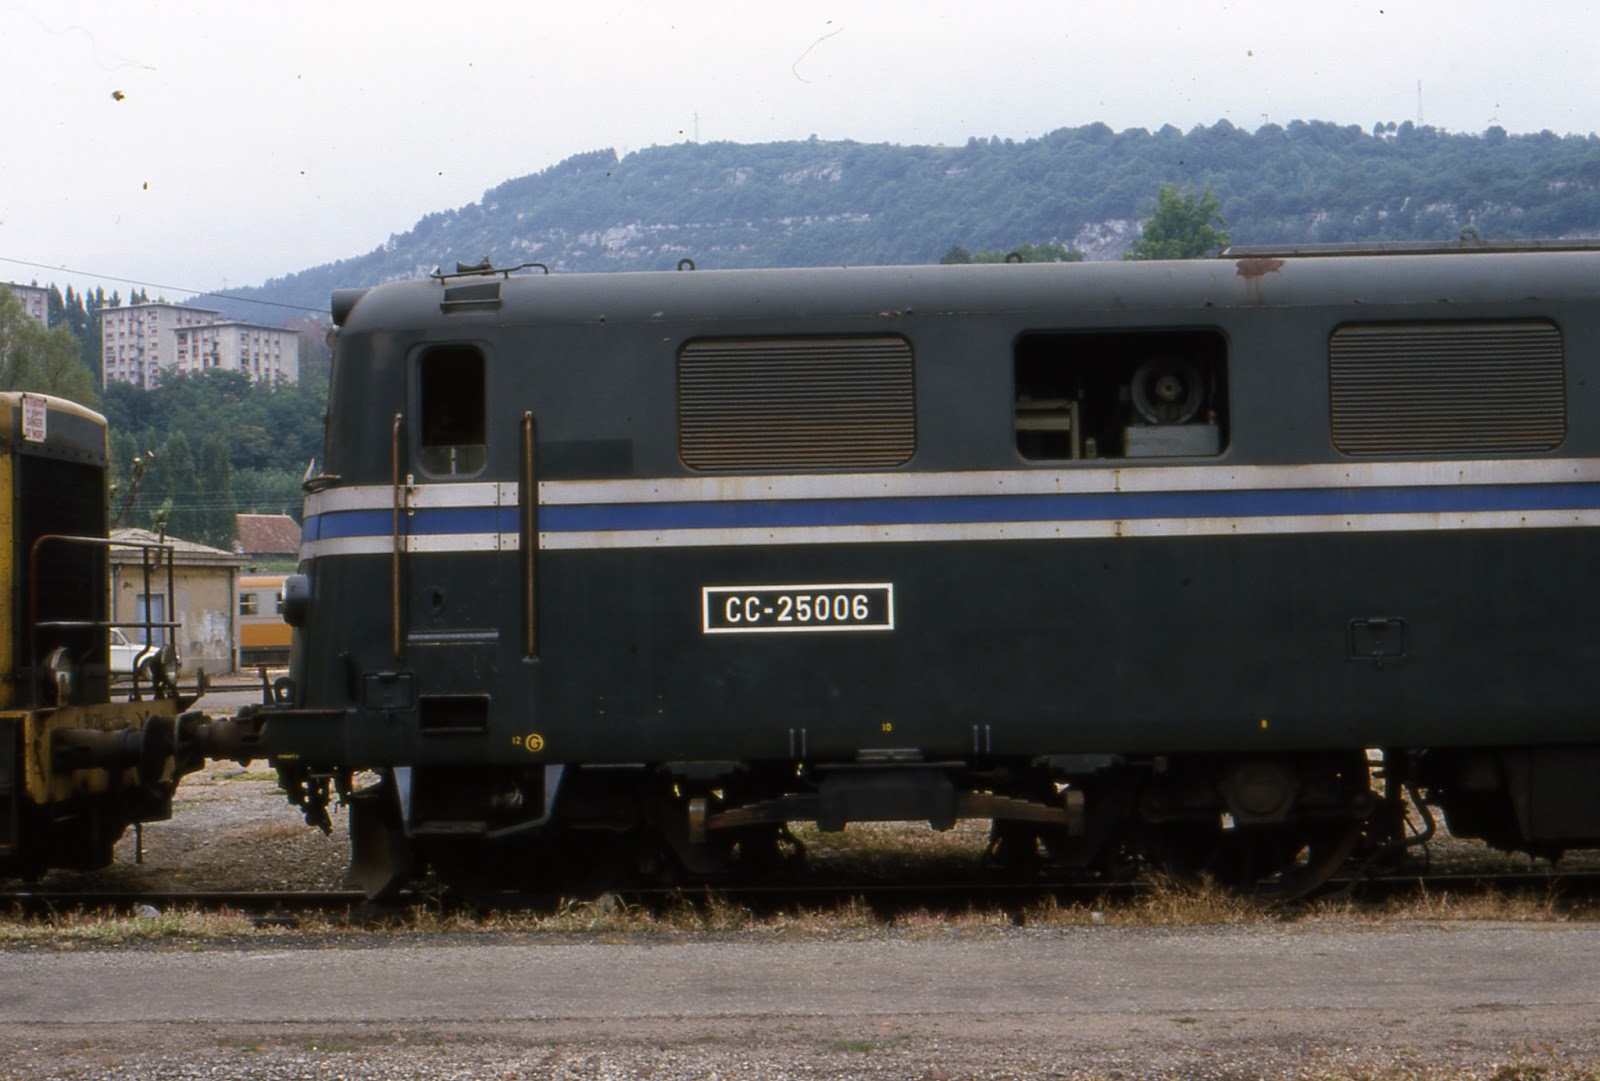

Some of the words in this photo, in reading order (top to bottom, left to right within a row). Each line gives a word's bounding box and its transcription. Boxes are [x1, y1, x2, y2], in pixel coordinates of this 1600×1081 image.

[725, 594, 869, 622] CC-25006
[881, 722, 892, 732] 10
[511, 735, 522, 745] 12
[527, 734, 542, 751] G
